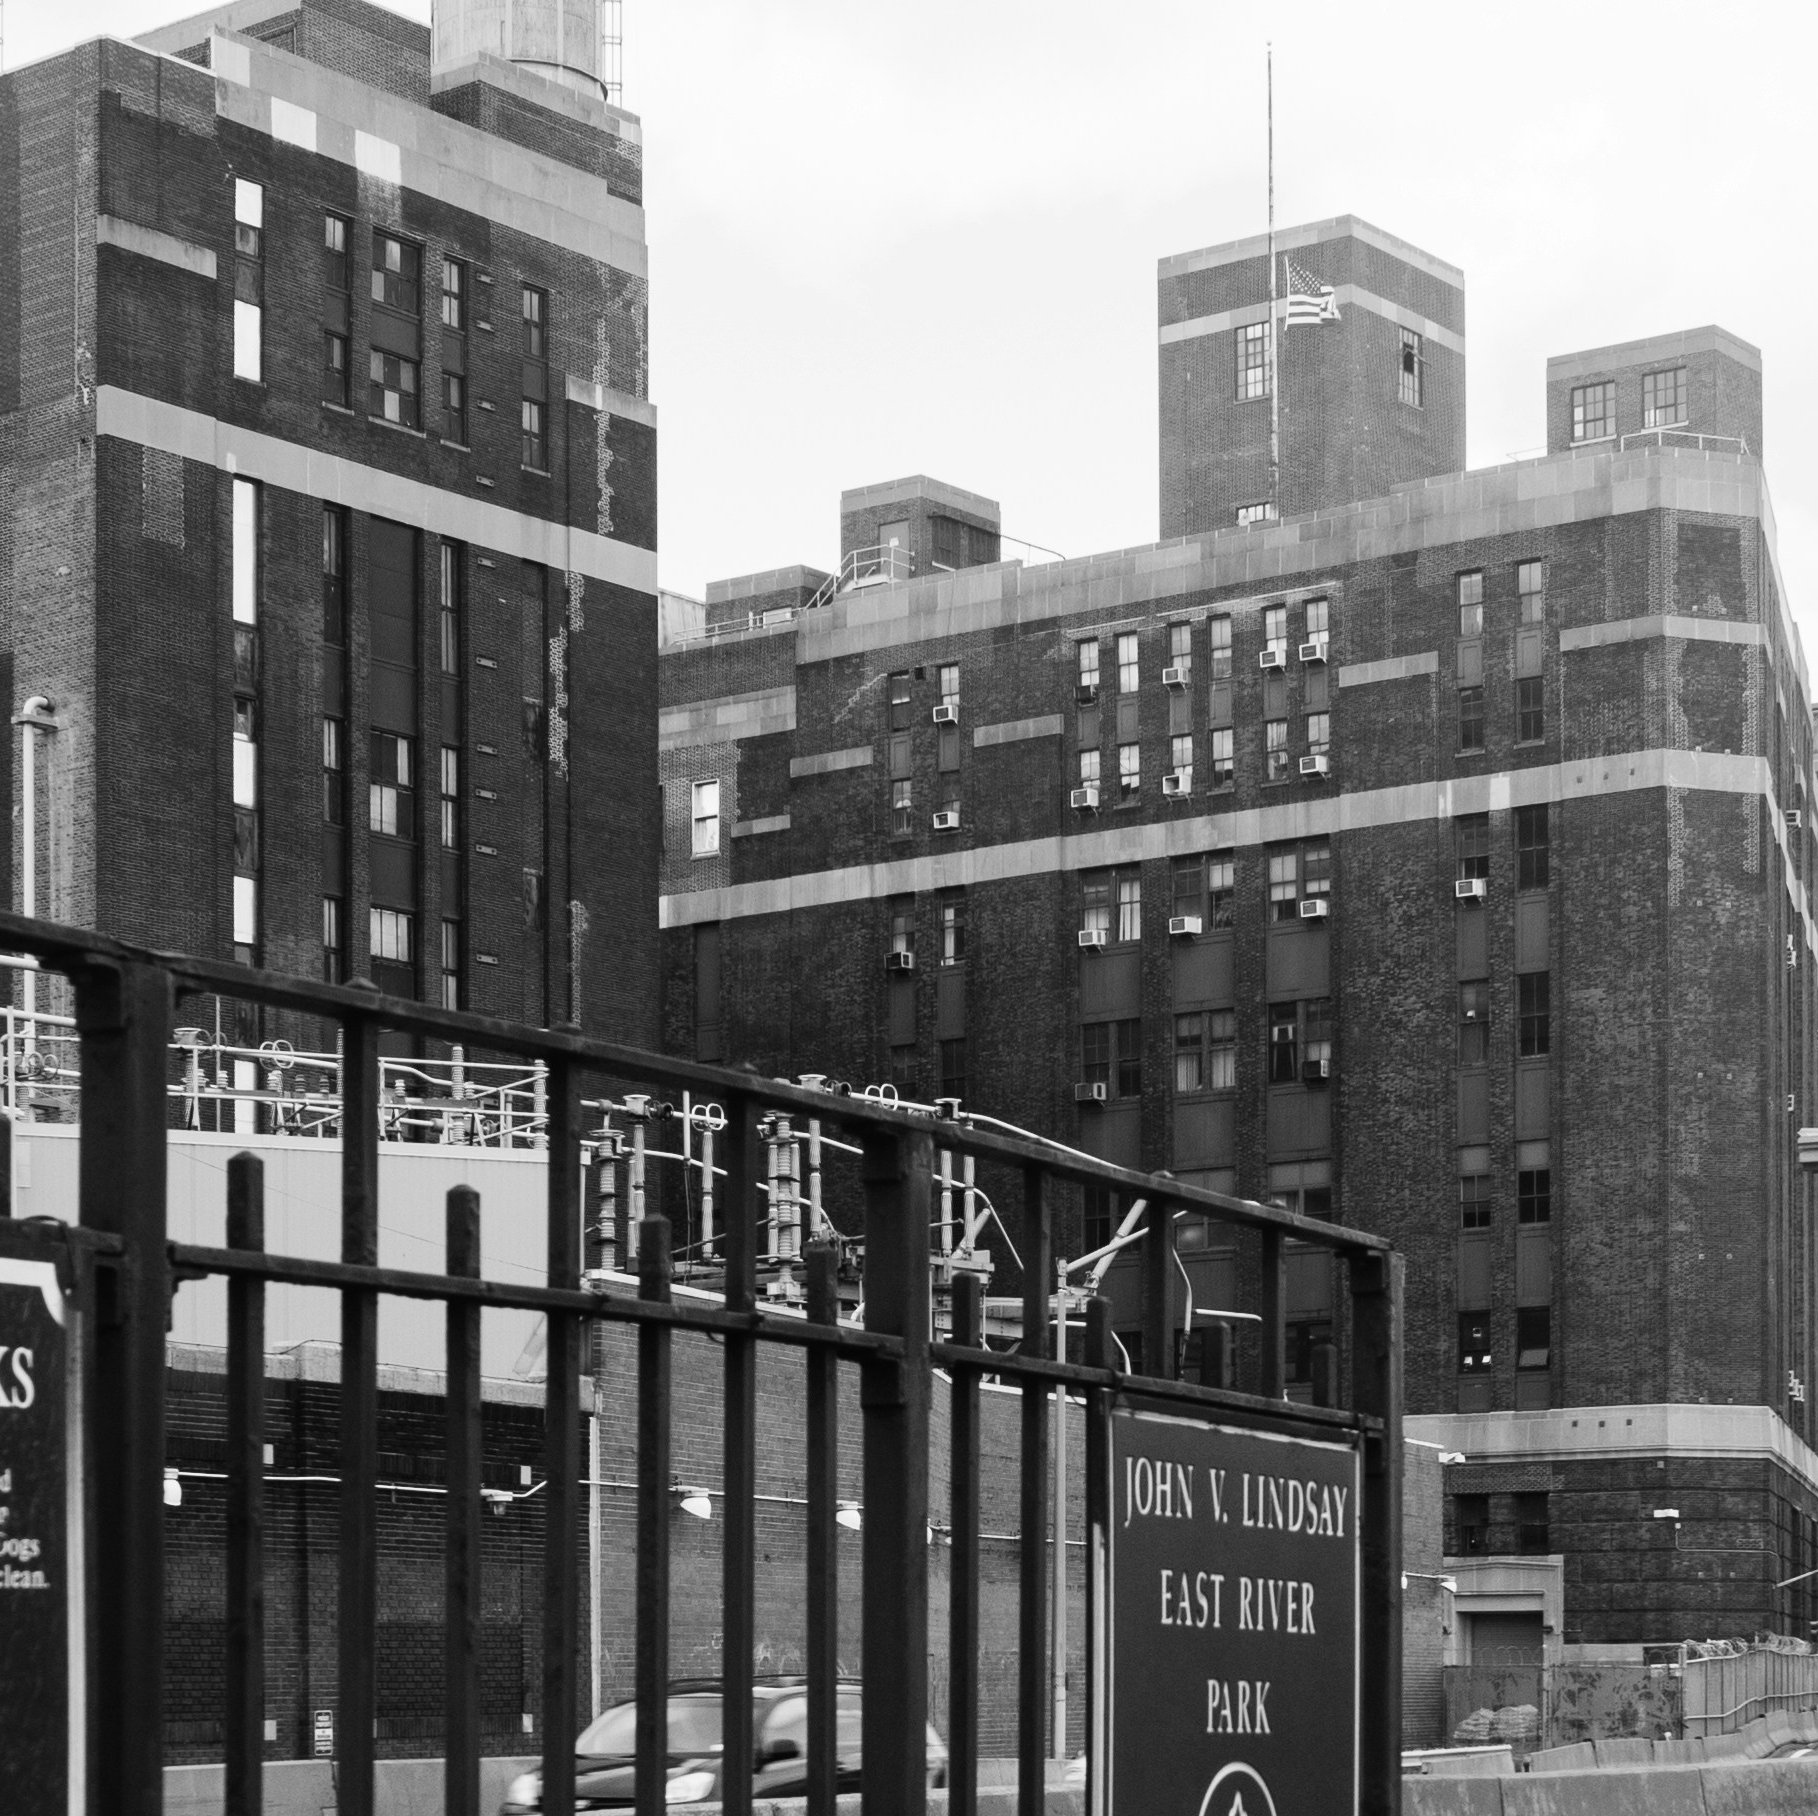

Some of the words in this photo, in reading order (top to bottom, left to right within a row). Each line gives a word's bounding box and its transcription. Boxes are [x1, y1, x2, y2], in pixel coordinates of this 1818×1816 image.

[1123, 1456, 1194, 1528] JOHN
[1208, 1468, 1228, 1523] V.
[1241, 1472, 1347, 1537] LINDSAY
[1160, 1568, 1225, 1628] EAST
[1238, 1576, 1315, 1634] RIVER
[1206, 1678, 1270, 1734] PARK
